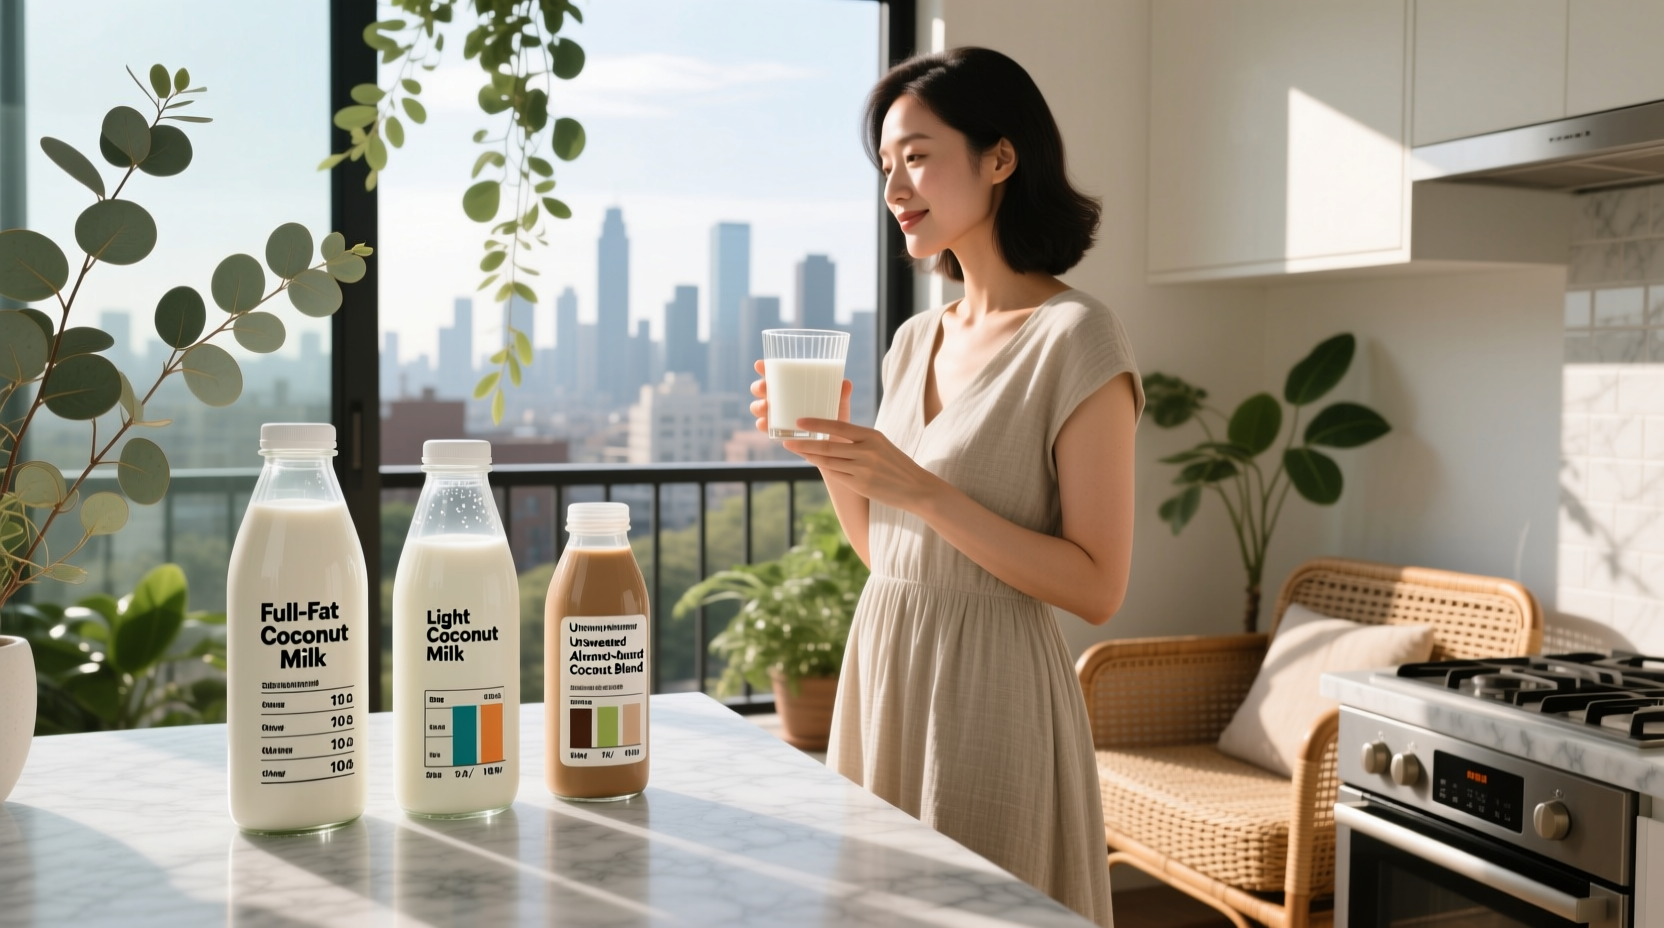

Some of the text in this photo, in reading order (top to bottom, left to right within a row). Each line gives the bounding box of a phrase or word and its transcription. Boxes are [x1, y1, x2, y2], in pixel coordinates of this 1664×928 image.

[261, 601, 339, 622] Full-Fat
[427, 608, 470, 630] Light
[261, 624, 349, 645] Coconut
[427, 626, 499, 643] Coconut
[281, 647, 327, 669] Milk
[427, 645, 465, 661] Milk
